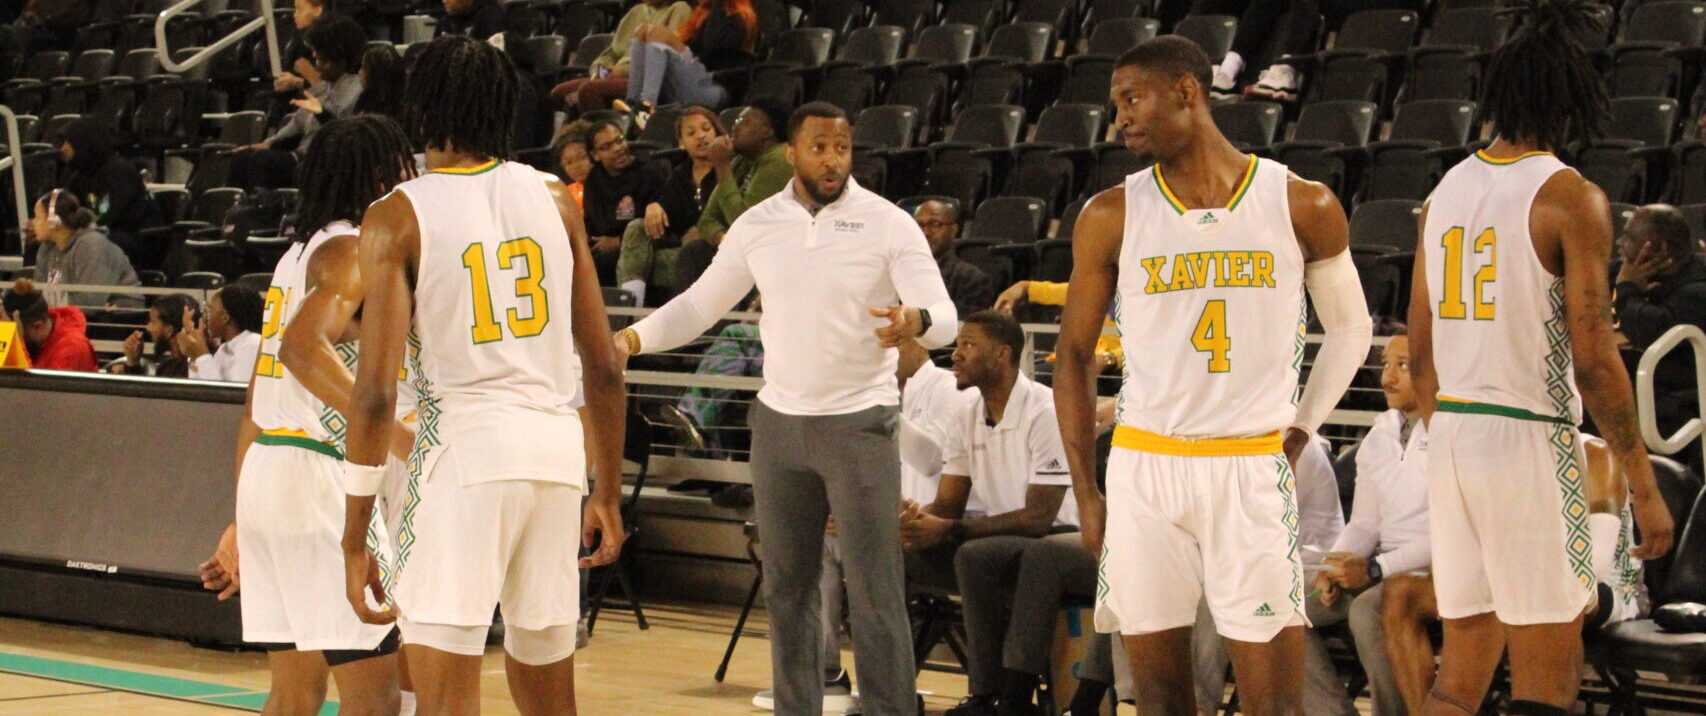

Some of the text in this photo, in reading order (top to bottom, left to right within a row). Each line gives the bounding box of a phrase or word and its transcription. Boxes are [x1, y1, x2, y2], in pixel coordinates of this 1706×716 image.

[461, 236, 550, 345] 13
[1140, 250, 1277, 295] XAVIER
[1439, 225, 1496, 321] 12
[1190, 299, 1231, 374] 4
